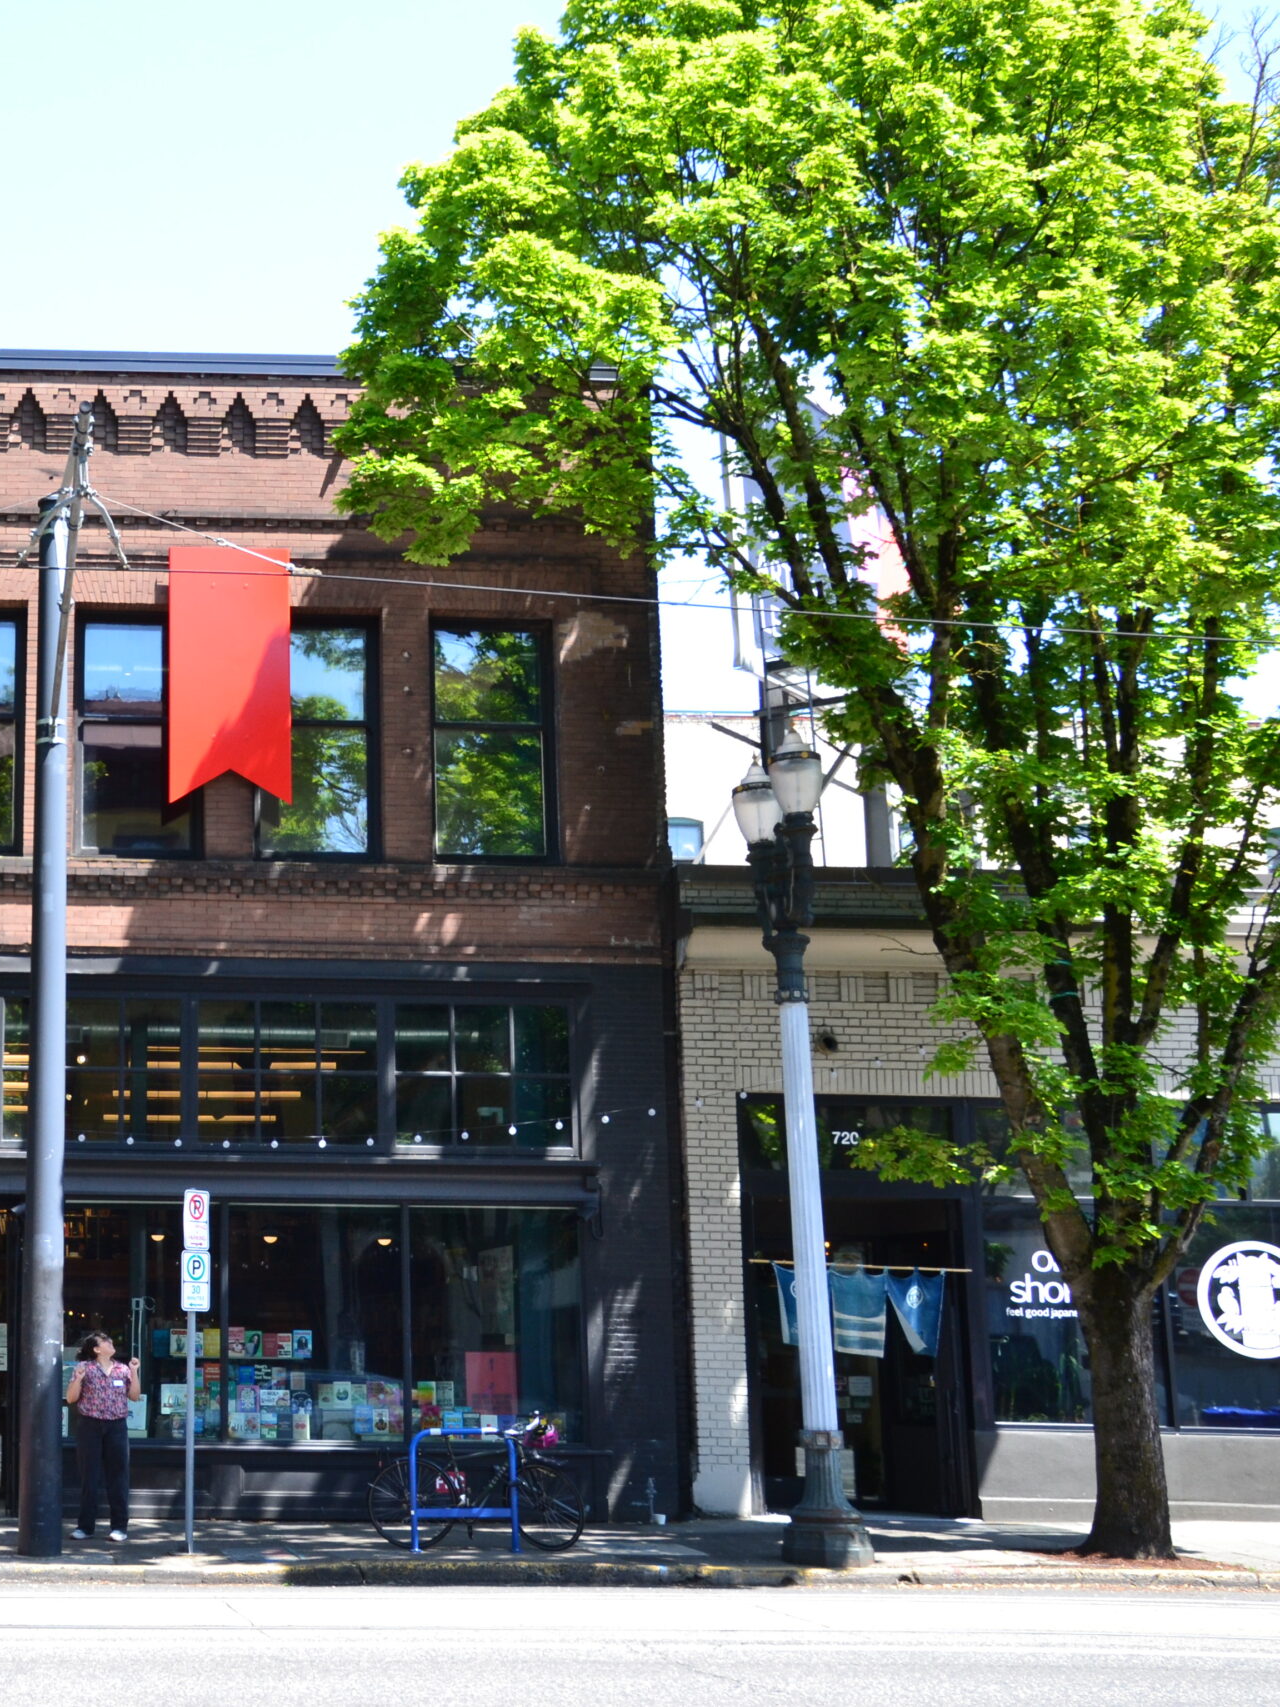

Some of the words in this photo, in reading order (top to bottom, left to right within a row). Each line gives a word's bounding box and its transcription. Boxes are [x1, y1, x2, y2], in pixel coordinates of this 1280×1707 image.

[831, 1131, 860, 1145] 720
[191, 1285, 201, 1294] 30
[1006, 1306, 1024, 1317] feel
[1025, 1307, 1050, 1319] good
